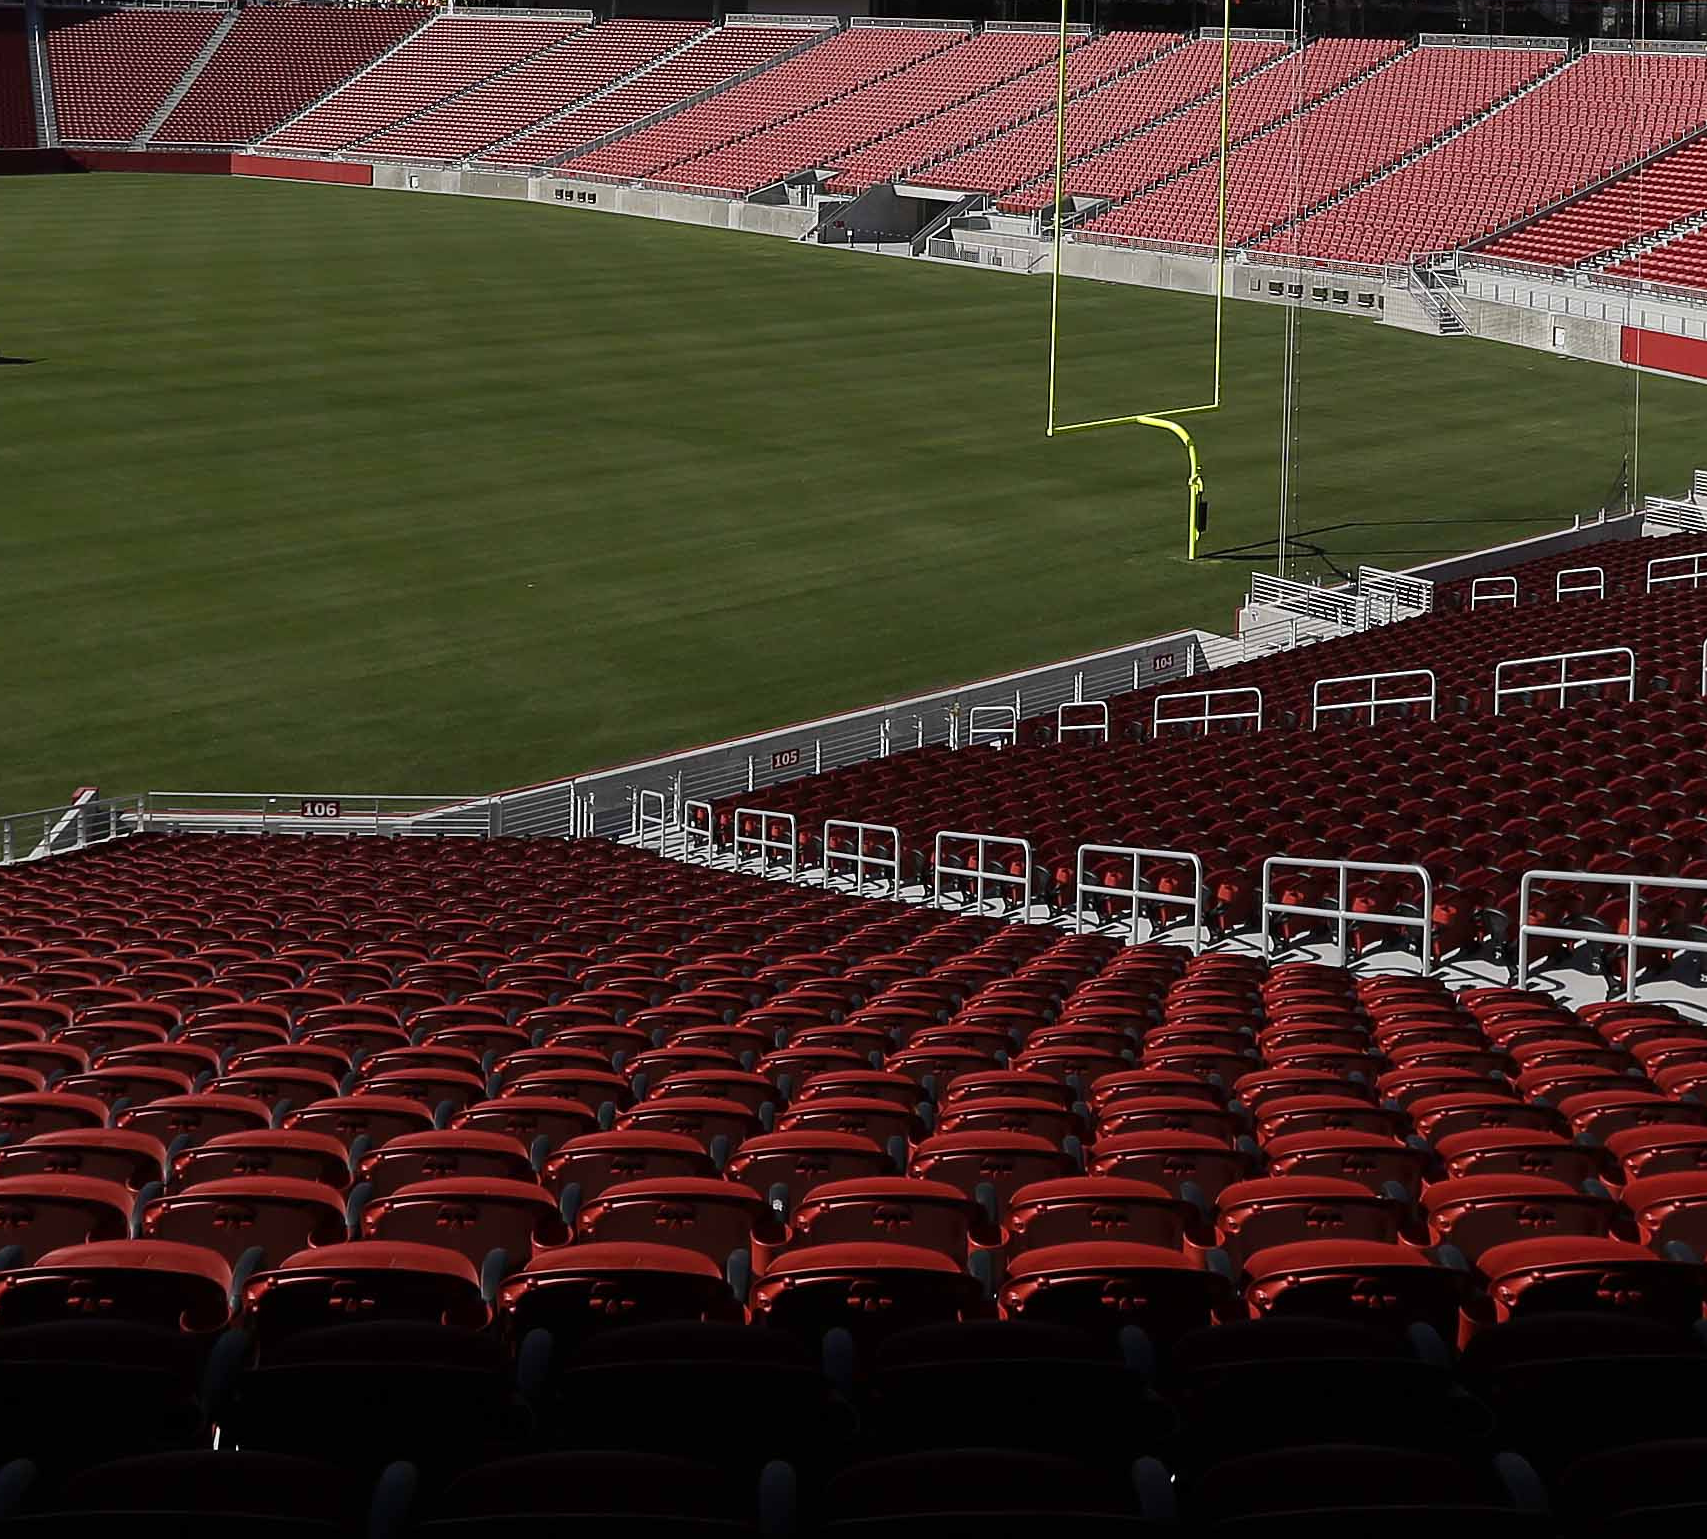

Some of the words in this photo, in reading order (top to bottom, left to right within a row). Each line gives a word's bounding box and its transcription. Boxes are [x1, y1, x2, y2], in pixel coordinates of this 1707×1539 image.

[1155, 655, 1173, 670] 104
[774, 750, 798, 768] 105
[303, 802, 338, 817] 106
